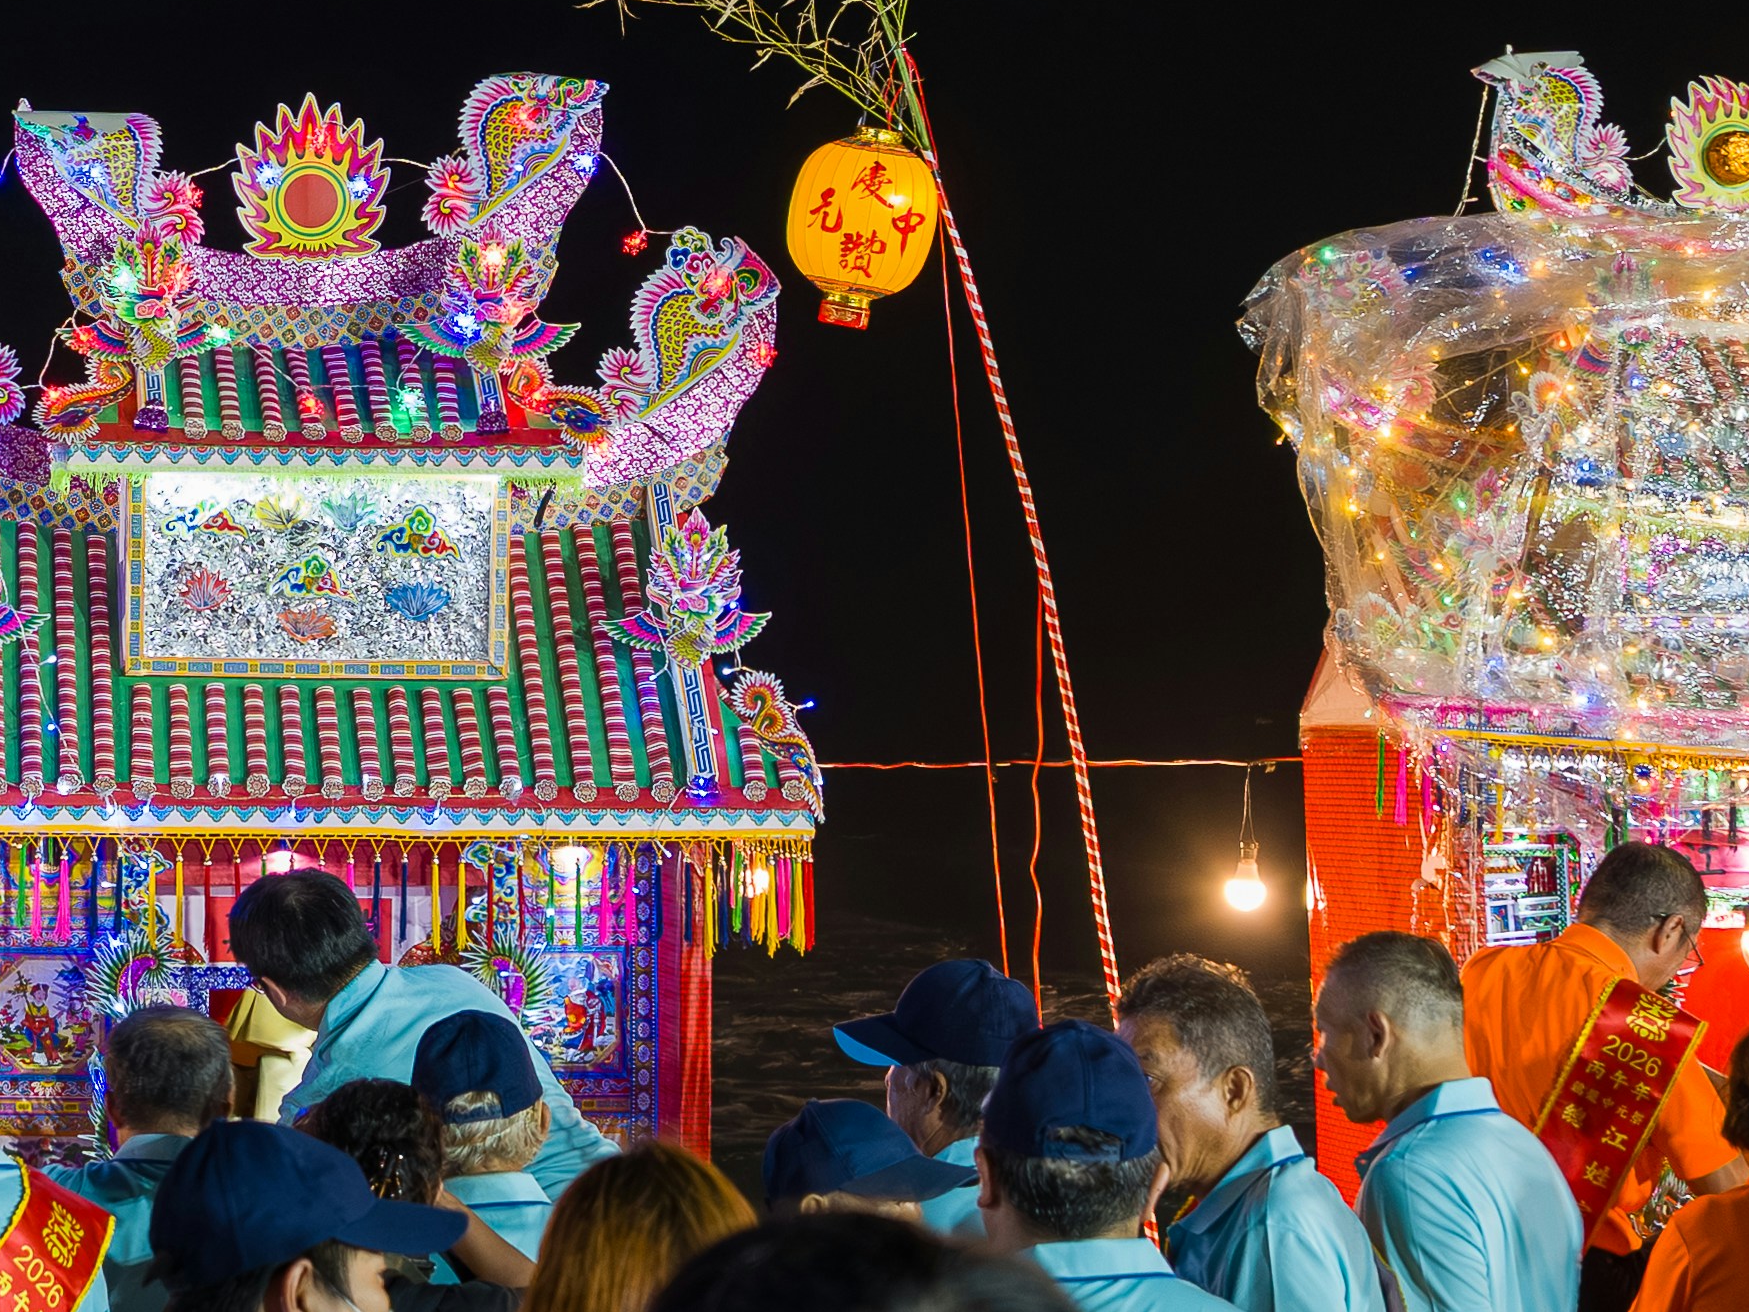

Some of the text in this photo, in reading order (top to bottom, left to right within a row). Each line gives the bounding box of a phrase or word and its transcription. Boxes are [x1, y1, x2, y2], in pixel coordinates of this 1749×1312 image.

[1601, 1034, 1662, 1077] 2026
[1584, 1060, 1652, 1102] 丙午年
[12, 1245, 65, 1308] 2026
